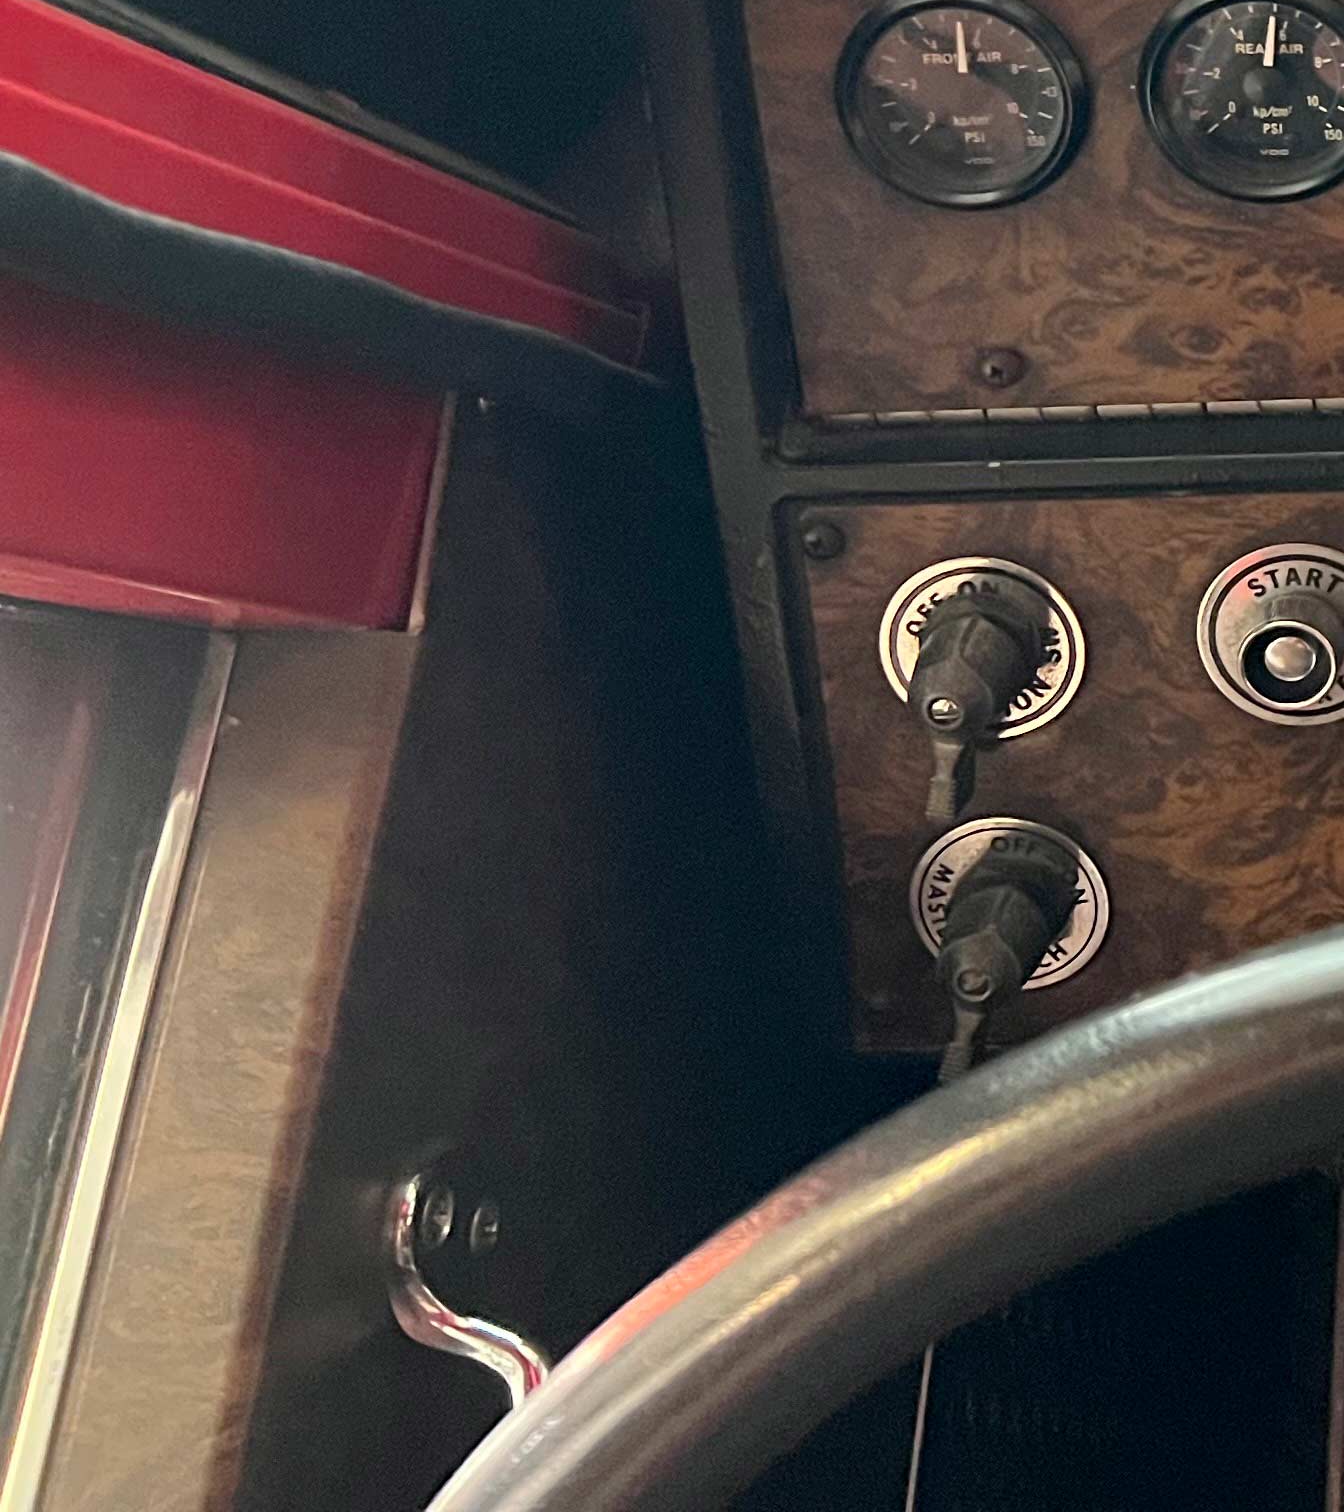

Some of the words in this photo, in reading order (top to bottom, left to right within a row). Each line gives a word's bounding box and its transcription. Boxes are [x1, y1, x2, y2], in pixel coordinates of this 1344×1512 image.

[1235, 43, 1273, 55] REA
[1279, 43, 1304, 55] AIR
[923, 53, 973, 65] FRO
[977, 52, 1001, 63] AIR
[1213, 68, 1221, 79] 2
[1229, 101, 1236, 113] 0
[1307, 95, 1319, 107] 10
[1263, 123, 1283, 134] PSI
[1324, 129, 1343, 141] 150
[1247, 567, 1344, 597] START
[928, 863, 955, 937] MAST
